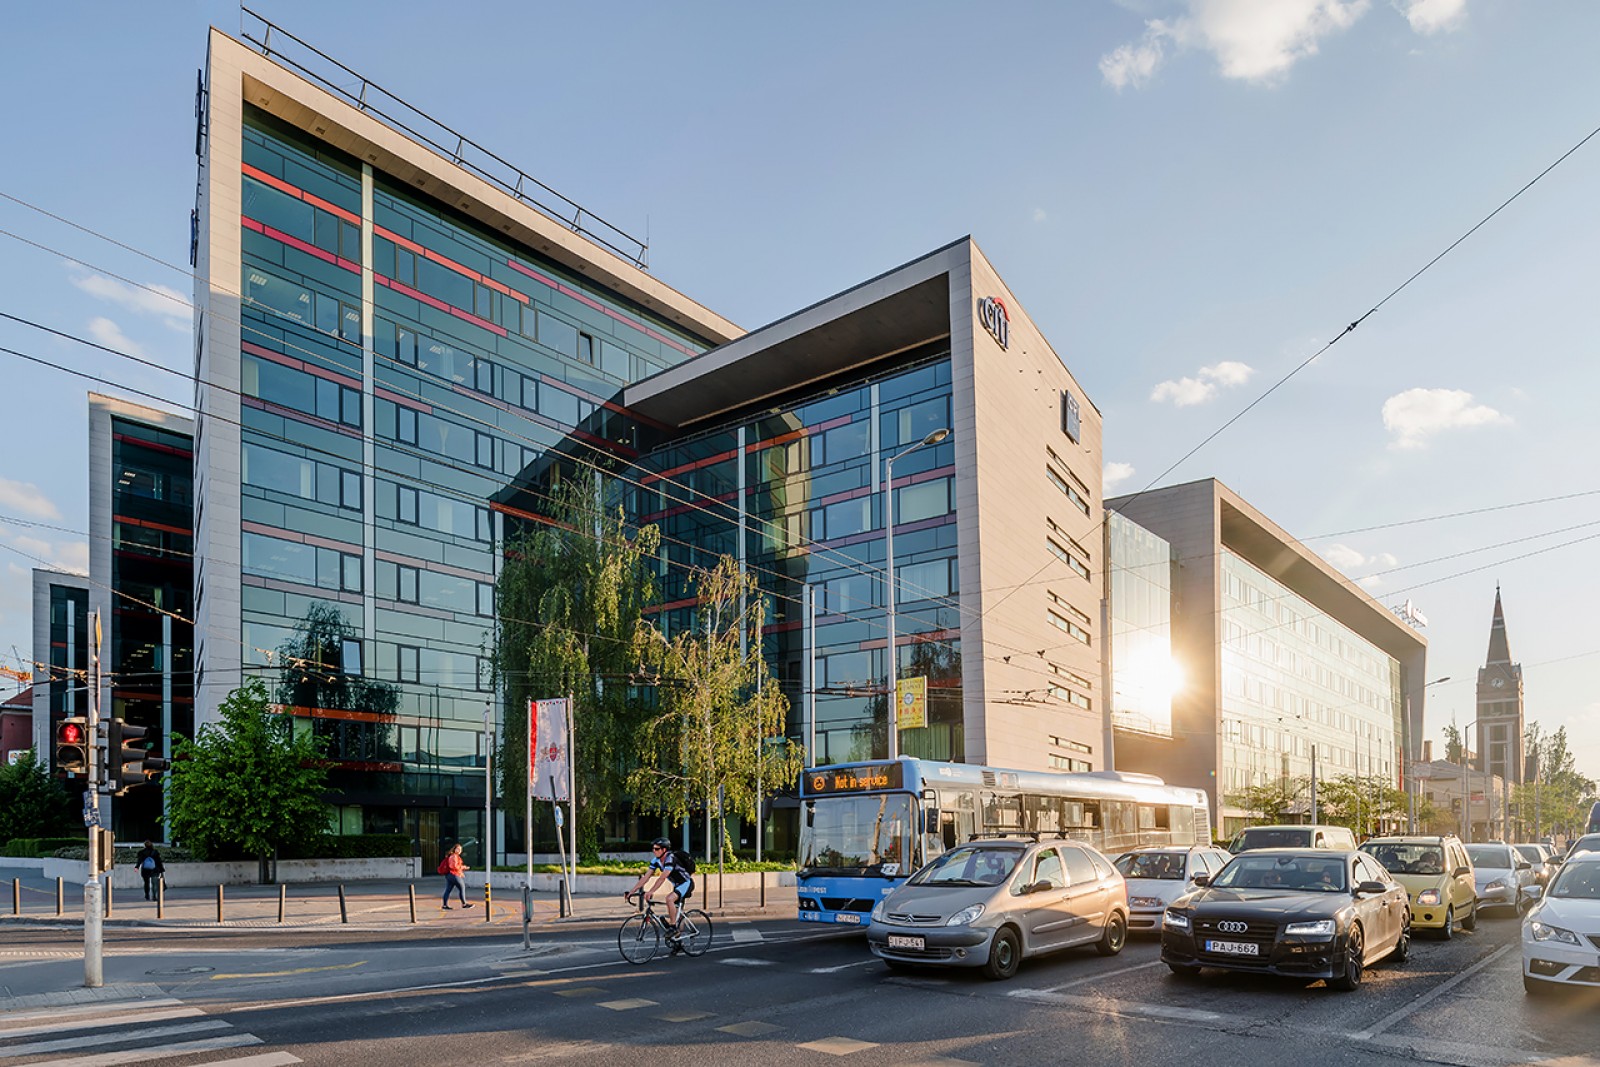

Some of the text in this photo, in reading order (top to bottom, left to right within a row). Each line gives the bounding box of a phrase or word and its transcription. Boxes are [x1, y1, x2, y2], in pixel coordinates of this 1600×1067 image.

[835, 774, 888, 789] Not in service
[1212, 942, 1256, 953] PAJ-662
